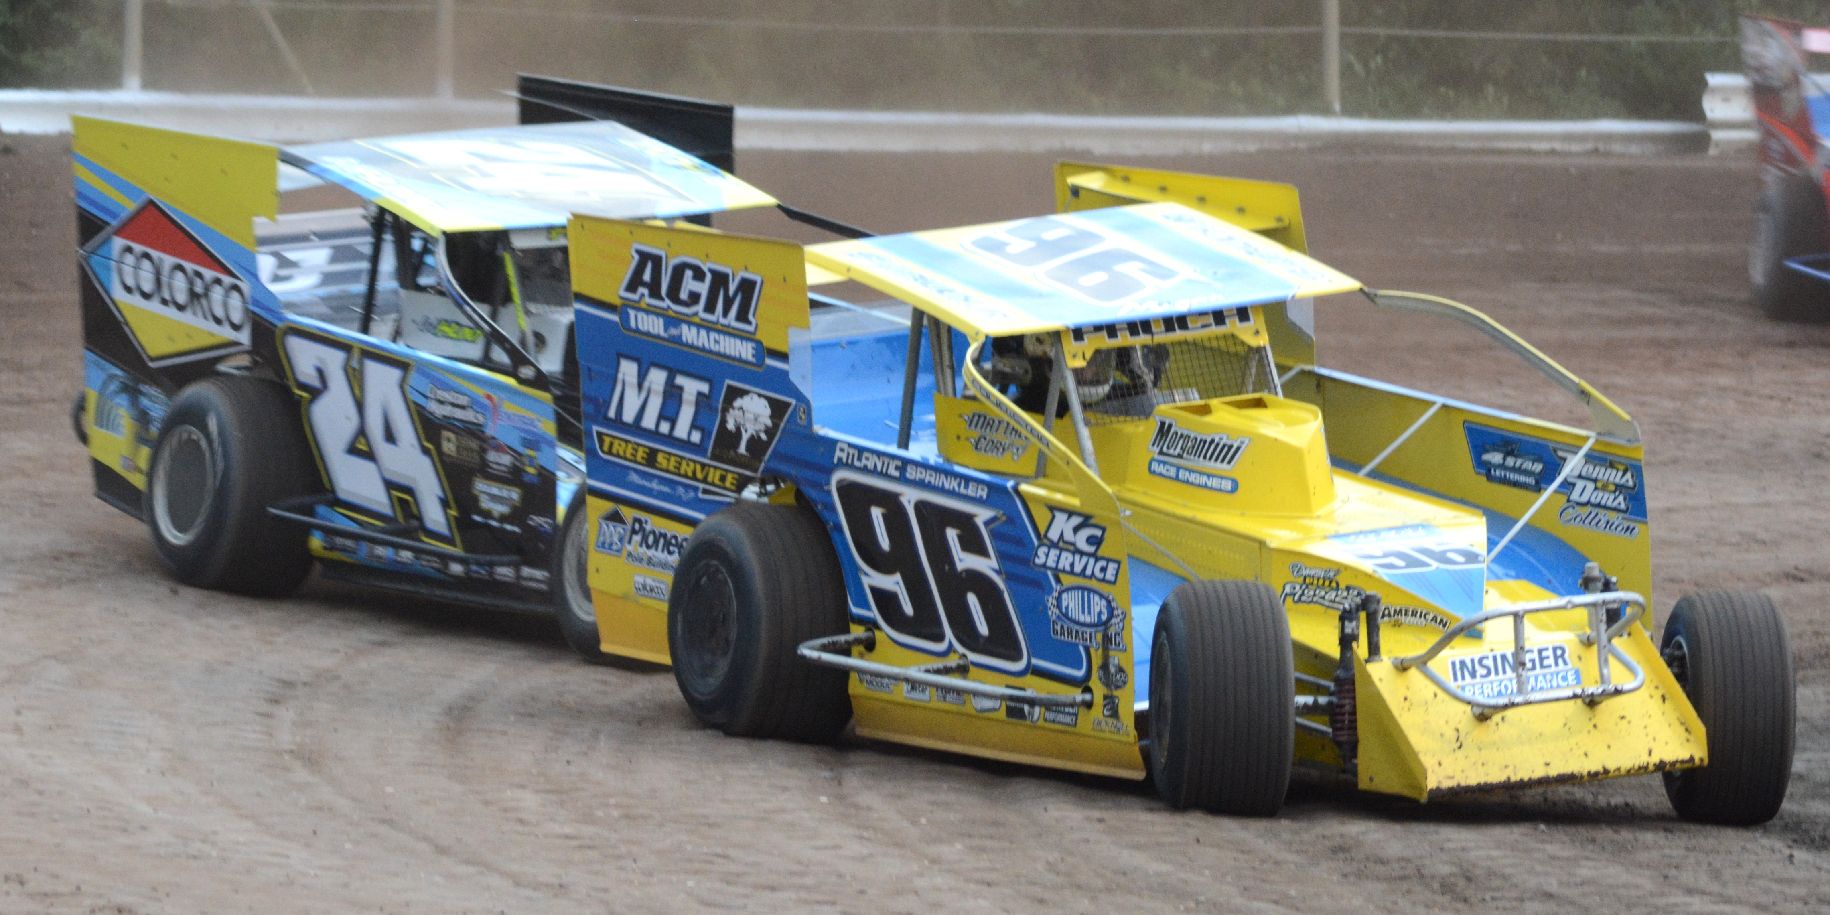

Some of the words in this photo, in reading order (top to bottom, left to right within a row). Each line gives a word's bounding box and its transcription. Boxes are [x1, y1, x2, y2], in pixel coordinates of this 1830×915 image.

[968, 215, 1181, 302] 96
[117, 245, 246, 331] COLORCO
[620, 246, 762, 333] ACM
[627, 308, 667, 338] TOOL
[681, 326, 757, 363] MACHINE
[606, 355, 711, 444] M.T.
[282, 332, 456, 541] 24
[600, 434, 653, 465] TREE
[655, 452, 740, 491] SERVICE
[1150, 418, 1247, 467] Morgantini
[833, 441, 903, 477] ATLANTIC
[905, 464, 988, 500] SPRINKLER
[1150, 460, 1178, 478] RACE
[1178, 468, 1233, 492] ENGINES
[1490, 467, 1536, 486] LETTERING
[1046, 507, 1105, 554] KC
[1559, 504, 1637, 536] Collision
[832, 470, 1027, 668] 96
[1034, 545, 1119, 583] SERVICE
[1061, 589, 1108, 624] PHILLIPS
[1380, 605, 1451, 631] AMERICAN
[1450, 645, 1569, 684] INSINGER
